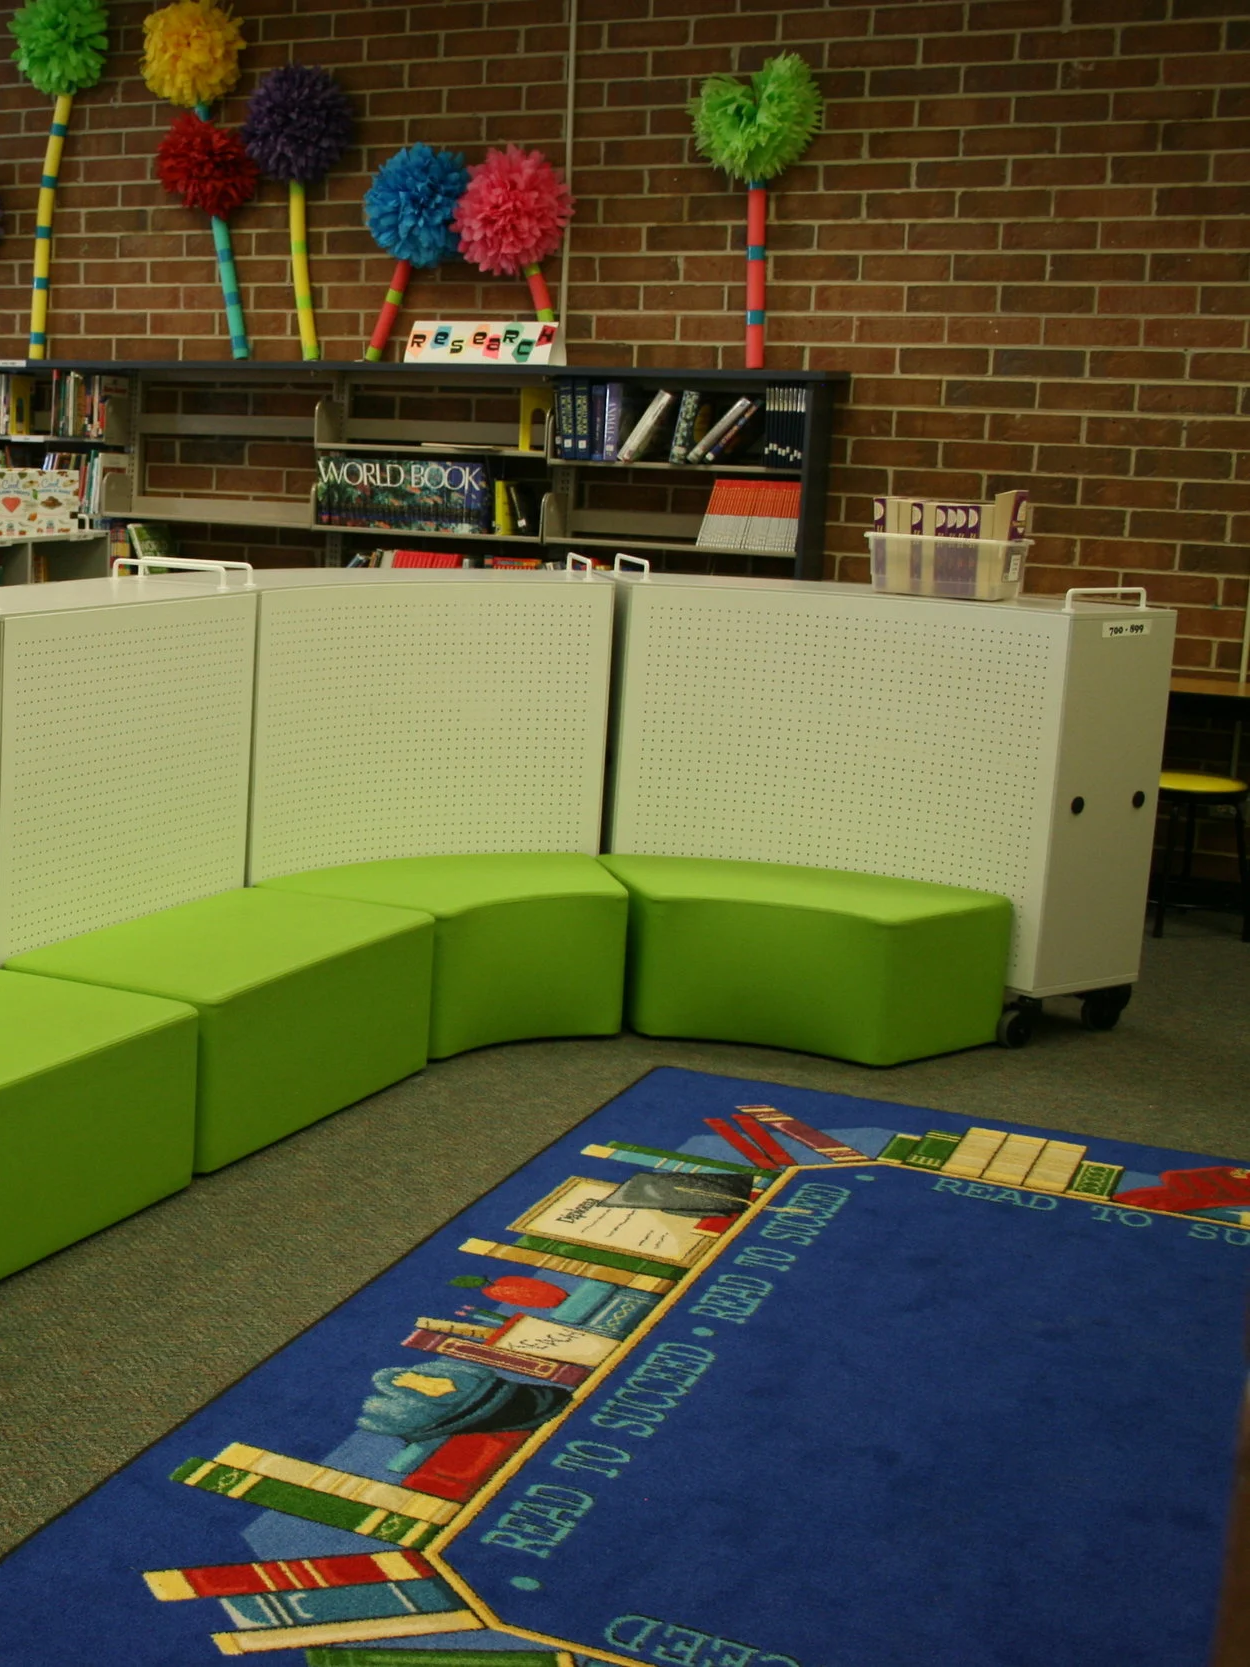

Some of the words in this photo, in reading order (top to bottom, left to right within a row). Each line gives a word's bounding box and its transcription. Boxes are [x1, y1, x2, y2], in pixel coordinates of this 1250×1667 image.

[607, 402, 616, 442] ANIMALS
[317, 459, 405, 487] WORLD
[411, 464, 482, 491] BOOK
[1109, 627, 1124, 636] 700
[1130, 624, 1144, 634] 899
[760, 1183, 852, 1246] SUCCEED
[928, 1178, 1058, 1211] READ
[1091, 1204, 1153, 1228] TO
[734, 1247, 797, 1272] TO
[688, 1274, 774, 1324] READ
[590, 1342, 717, 1438] SUCCEED
[551, 1440, 633, 1478] TO
[480, 1484, 595, 1559] READ
